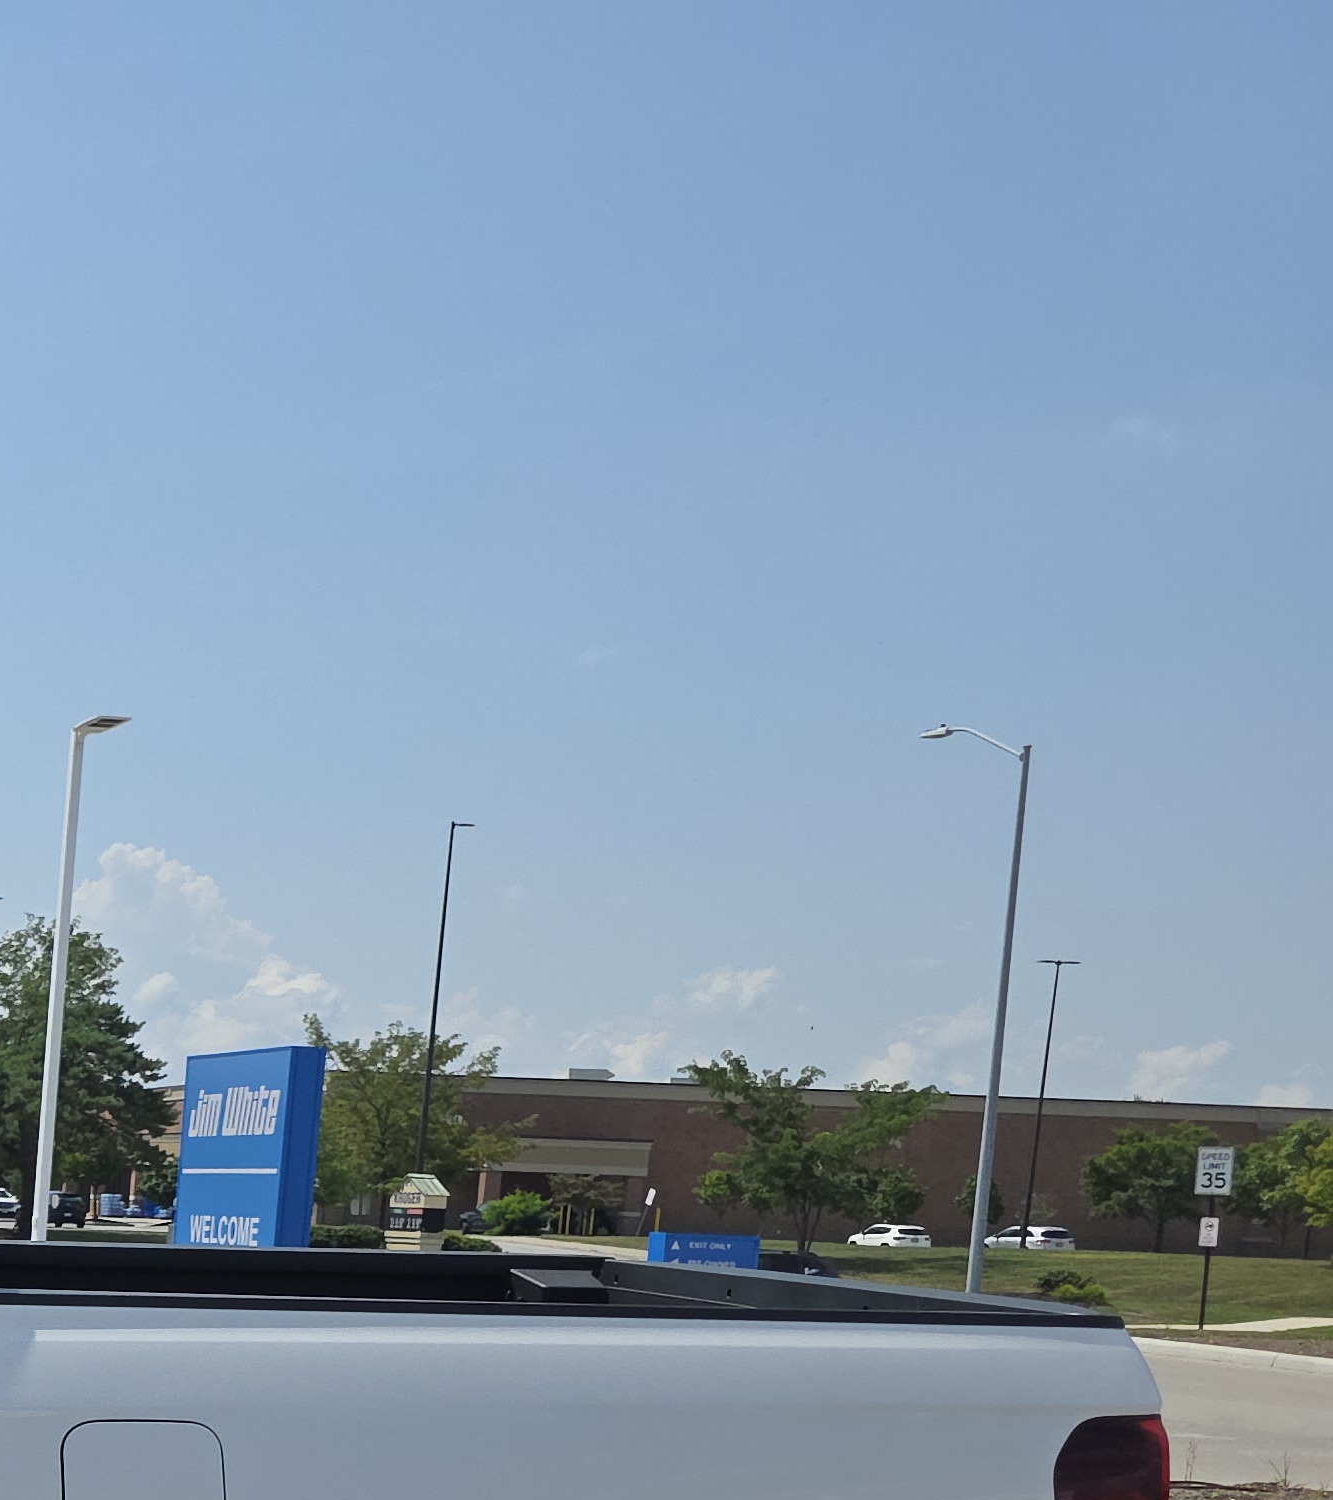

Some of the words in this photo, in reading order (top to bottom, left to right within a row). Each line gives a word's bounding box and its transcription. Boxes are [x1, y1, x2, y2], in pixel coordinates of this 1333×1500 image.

[221, 1085, 282, 1137] White
[1201, 1152, 1231, 1161] SPEED
[1203, 1162, 1226, 1170] LIMIT
[1201, 1172, 1226, 1188] 35
[190, 1214, 260, 1248] WELCOME
[709, 1242, 732, 1250] ONLY
